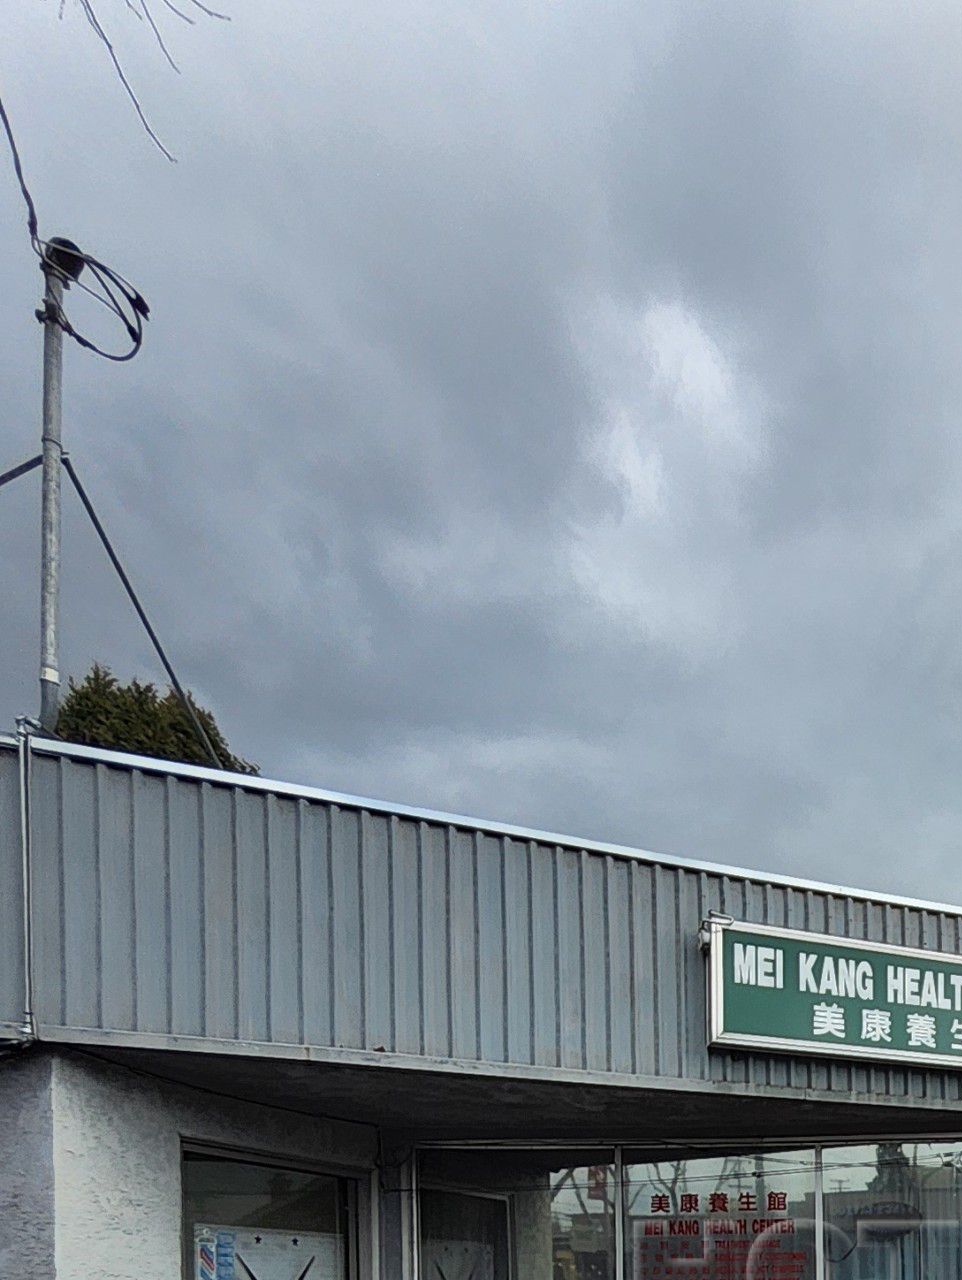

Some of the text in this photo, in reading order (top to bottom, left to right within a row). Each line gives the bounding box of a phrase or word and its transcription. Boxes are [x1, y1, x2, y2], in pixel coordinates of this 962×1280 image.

[733, 943, 784, 989] MEI
[798, 952, 874, 1000] KANG
[651, 1191, 787, 1213] 美康養生館
[645, 1218, 795, 1236] MEI KANG HEALTH CENTER
